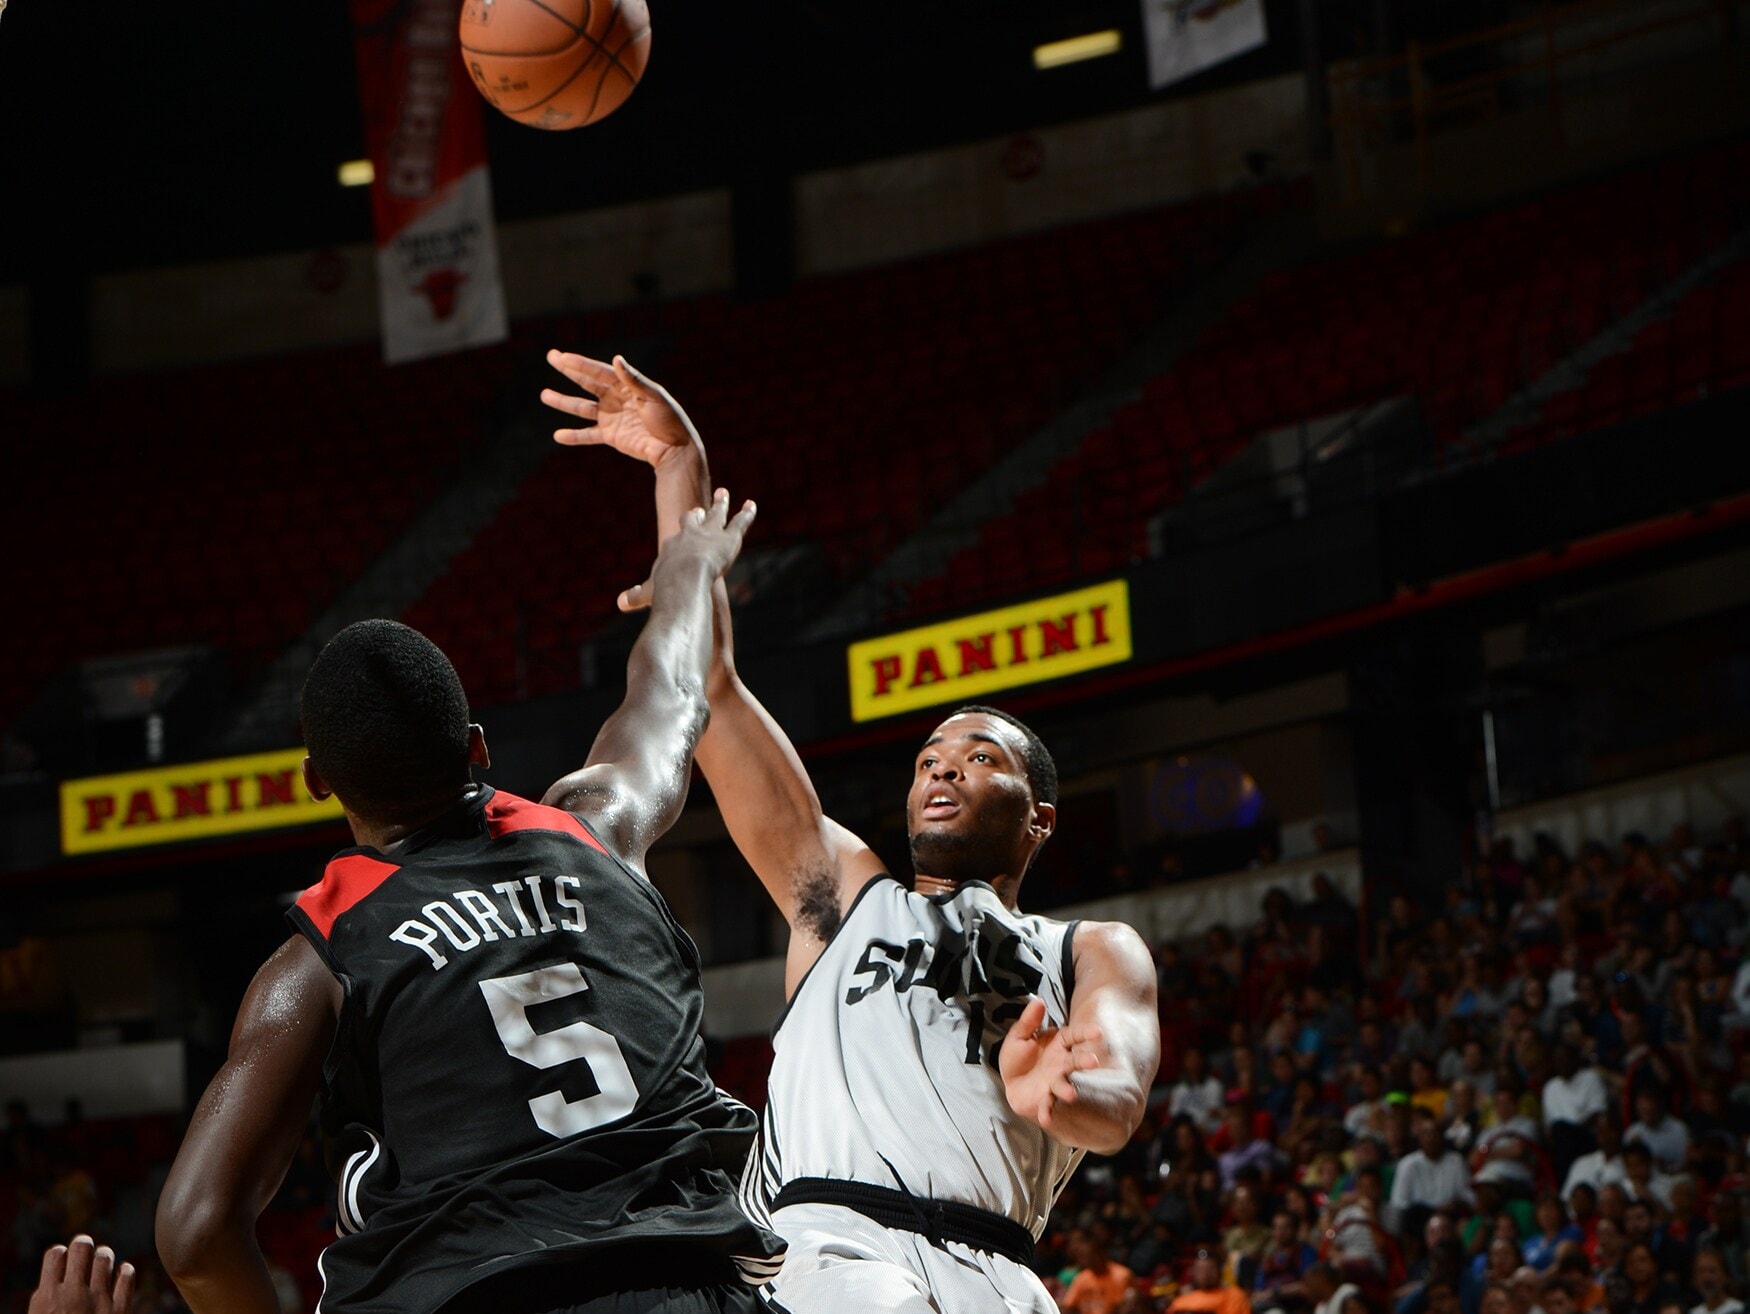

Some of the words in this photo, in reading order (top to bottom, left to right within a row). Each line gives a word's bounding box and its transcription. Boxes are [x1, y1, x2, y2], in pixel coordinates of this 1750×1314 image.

[872, 604, 1109, 697] PANINI
[85, 768, 296, 832] PANIN
[388, 875, 588, 971] PORTIS
[477, 961, 640, 1140] 5
